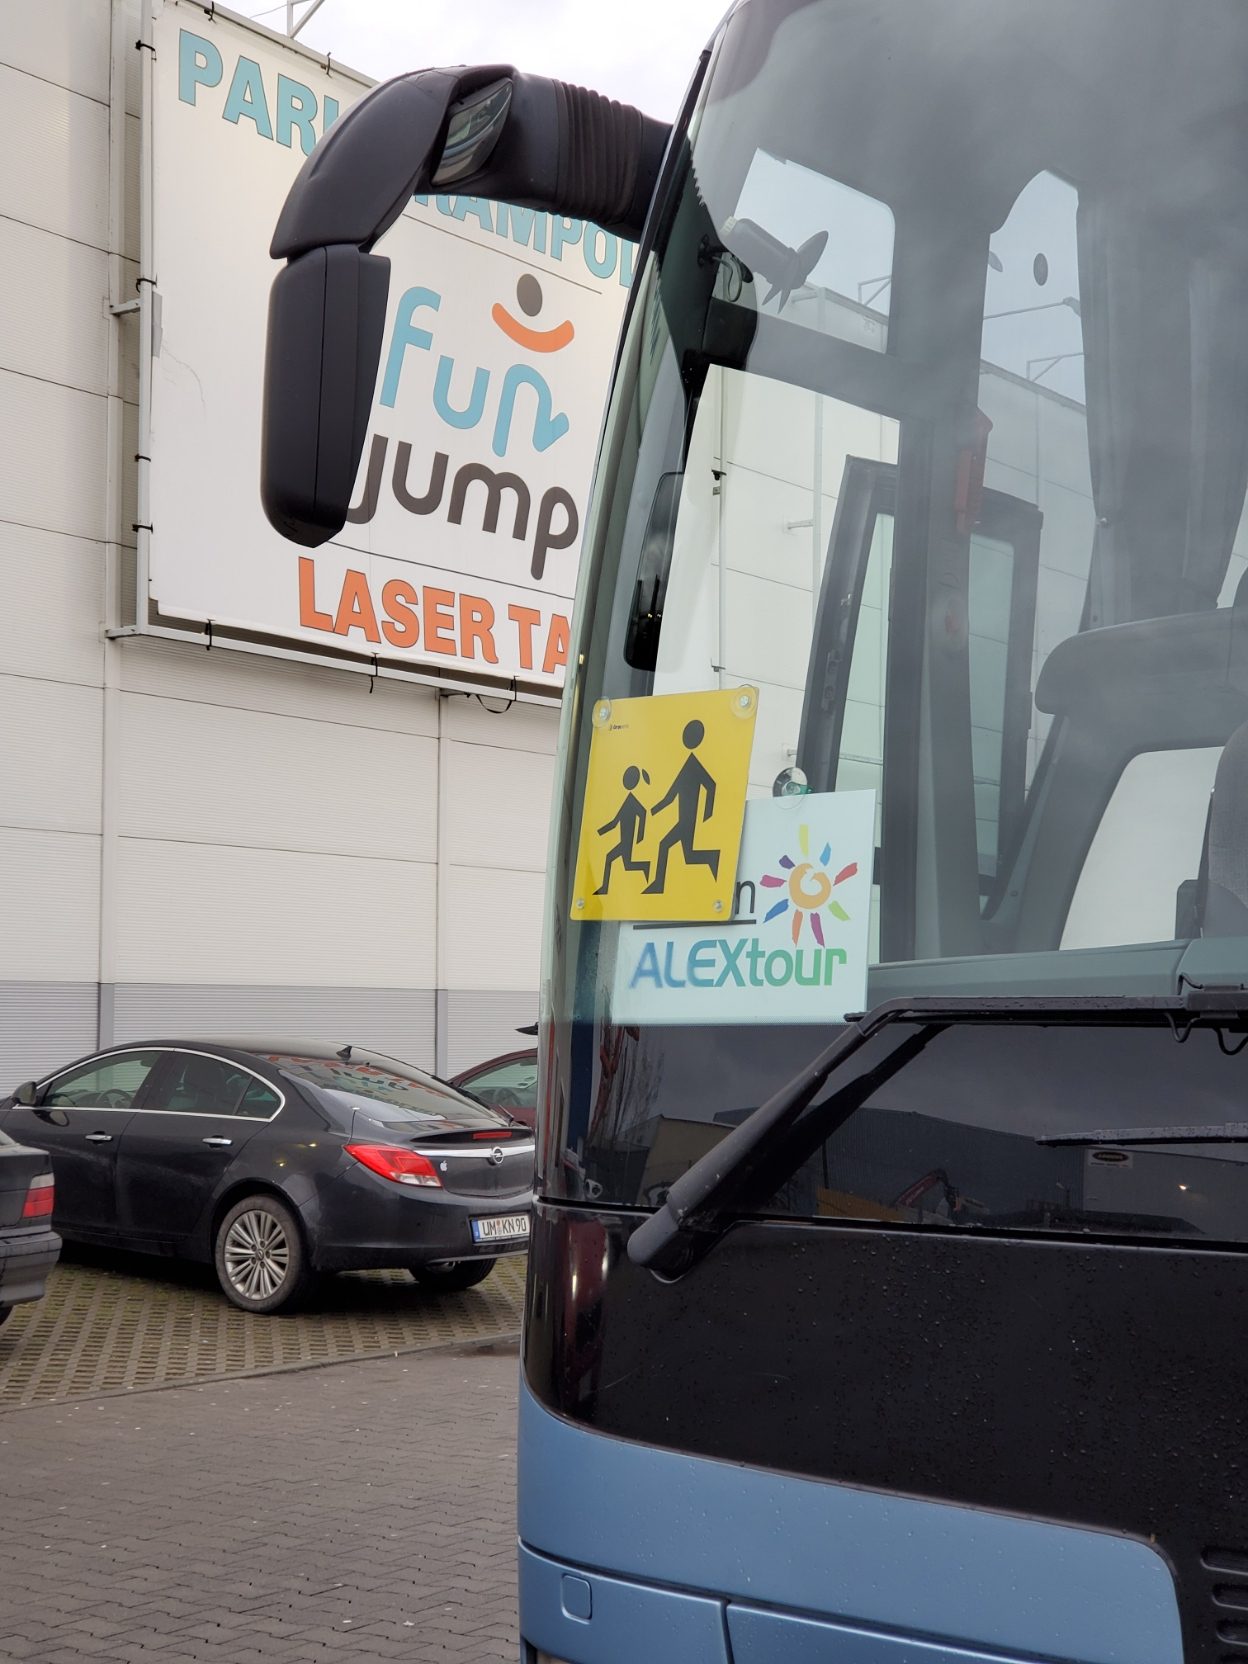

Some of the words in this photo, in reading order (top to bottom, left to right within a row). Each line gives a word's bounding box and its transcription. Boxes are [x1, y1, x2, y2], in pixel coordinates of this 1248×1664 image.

[379, 286, 570, 458] fun
[346, 433, 579, 581] jump
[298, 556, 499, 664] LASER
[628, 938, 847, 989] ALEXtour
[501, 1219, 515, 1234] KN
